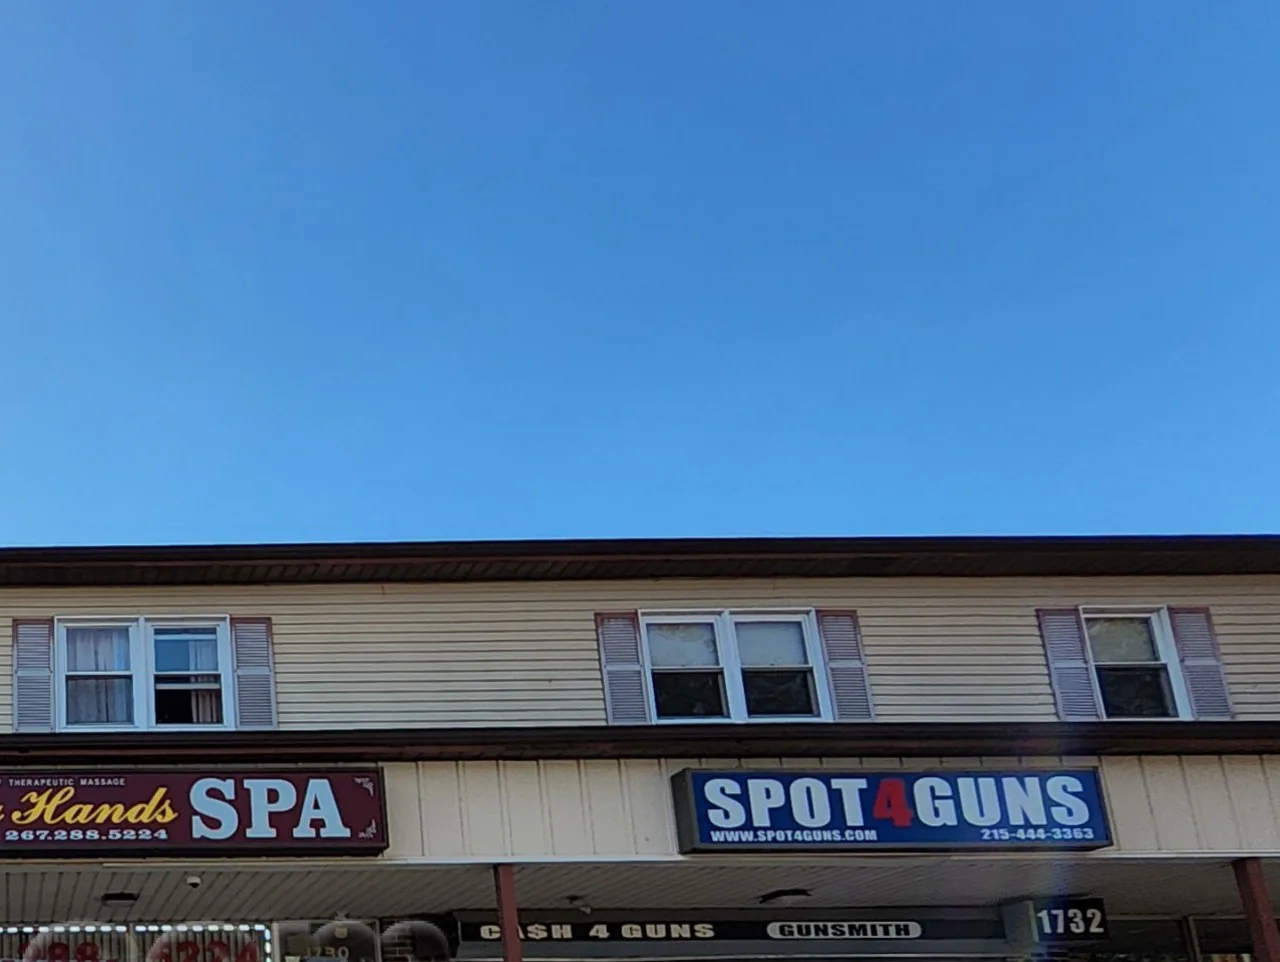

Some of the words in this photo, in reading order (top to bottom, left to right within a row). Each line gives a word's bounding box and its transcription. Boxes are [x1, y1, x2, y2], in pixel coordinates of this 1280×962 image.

[9, 778, 74, 787] THERAPEUTIC
[80, 778, 126, 786] MASSAGE
[11, 786, 179, 825] Hands
[189, 778, 351, 840] SPA
[703, 776, 1091, 828] SPOT4GUNS
[4, 829, 169, 841] 267.288.5224
[710, 829, 878, 842] WWW.SPOT4GUNS.COM
[980, 828, 1095, 840] 215-444-3363
[1037, 908, 1105, 934] 1732
[480, 923, 573, 940] C$H
[588, 923, 610, 938] 4
[621, 923, 716, 938] GUNS
[779, 923, 910, 937] GUNSMITH
